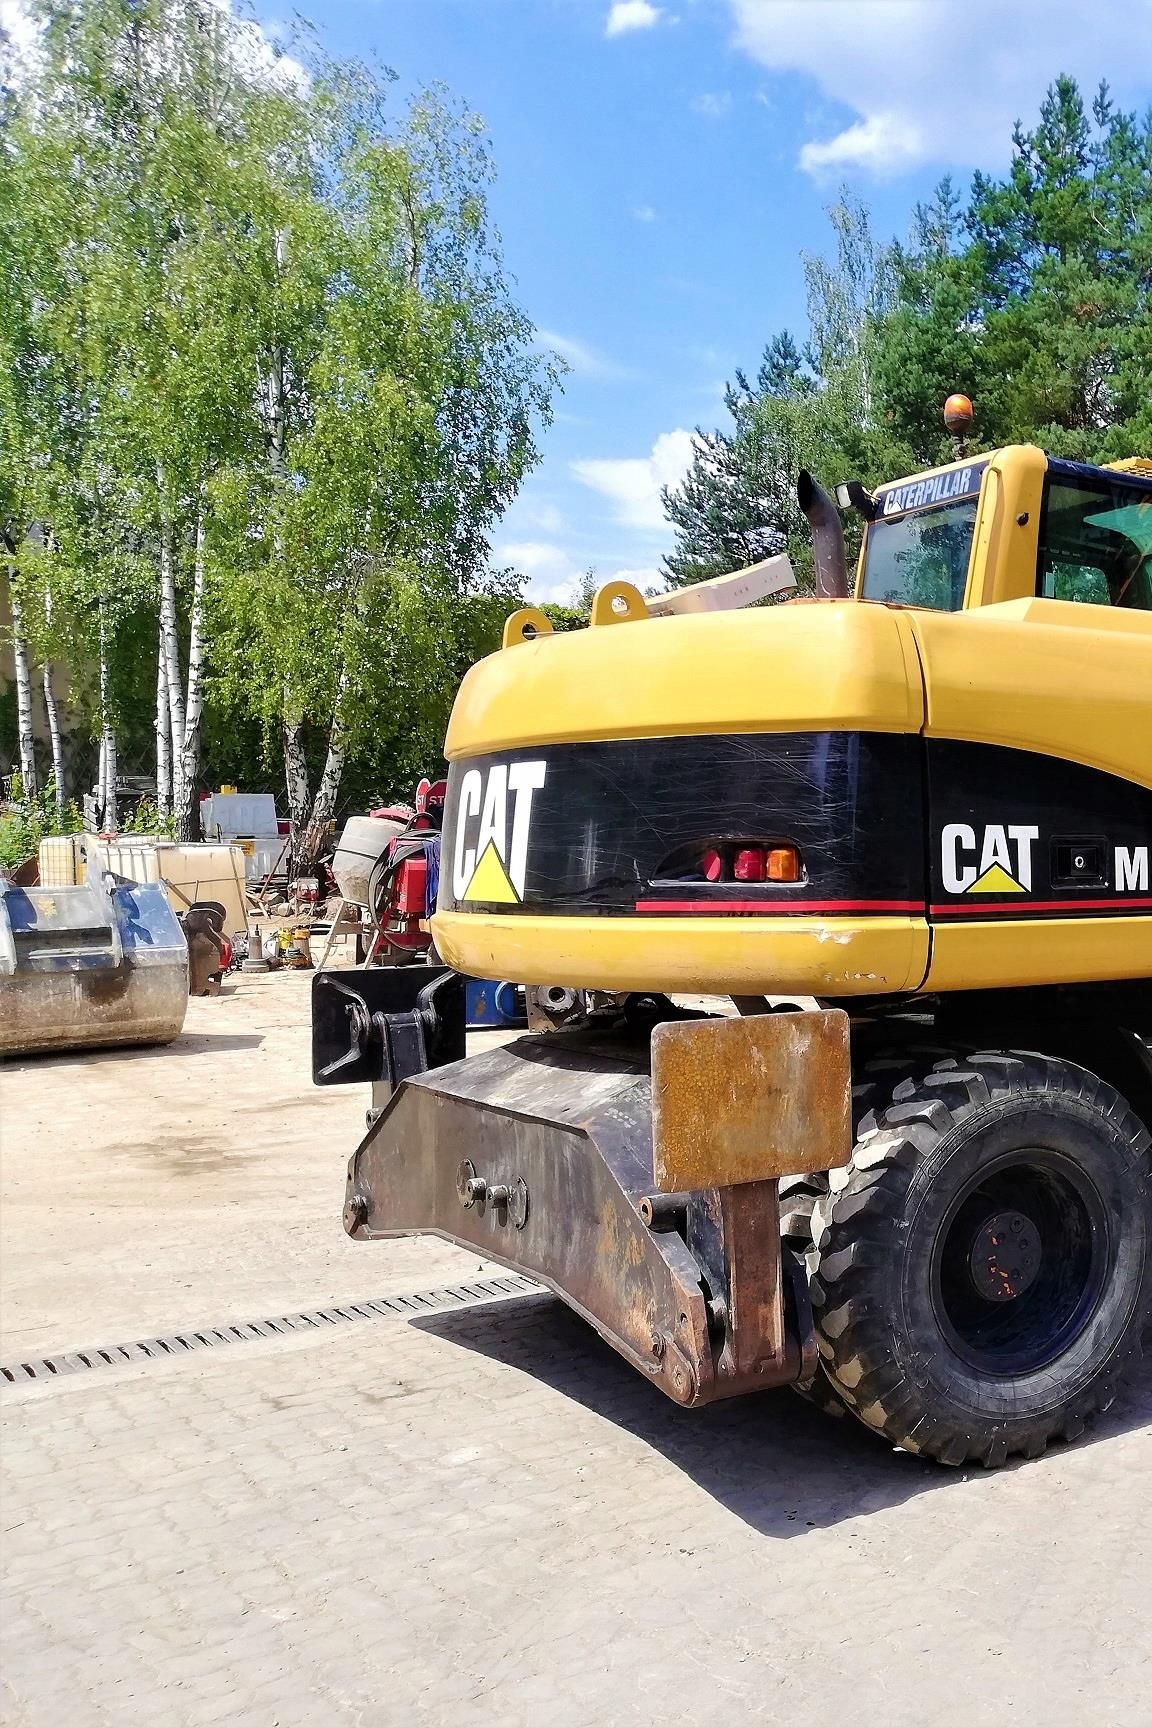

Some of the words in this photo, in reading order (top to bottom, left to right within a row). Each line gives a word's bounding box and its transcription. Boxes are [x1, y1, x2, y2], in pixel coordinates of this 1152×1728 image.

[883, 468, 972, 515] CATERPILLAR
[453, 761, 547, 904] CAT
[941, 823, 1039, 894] CAT
